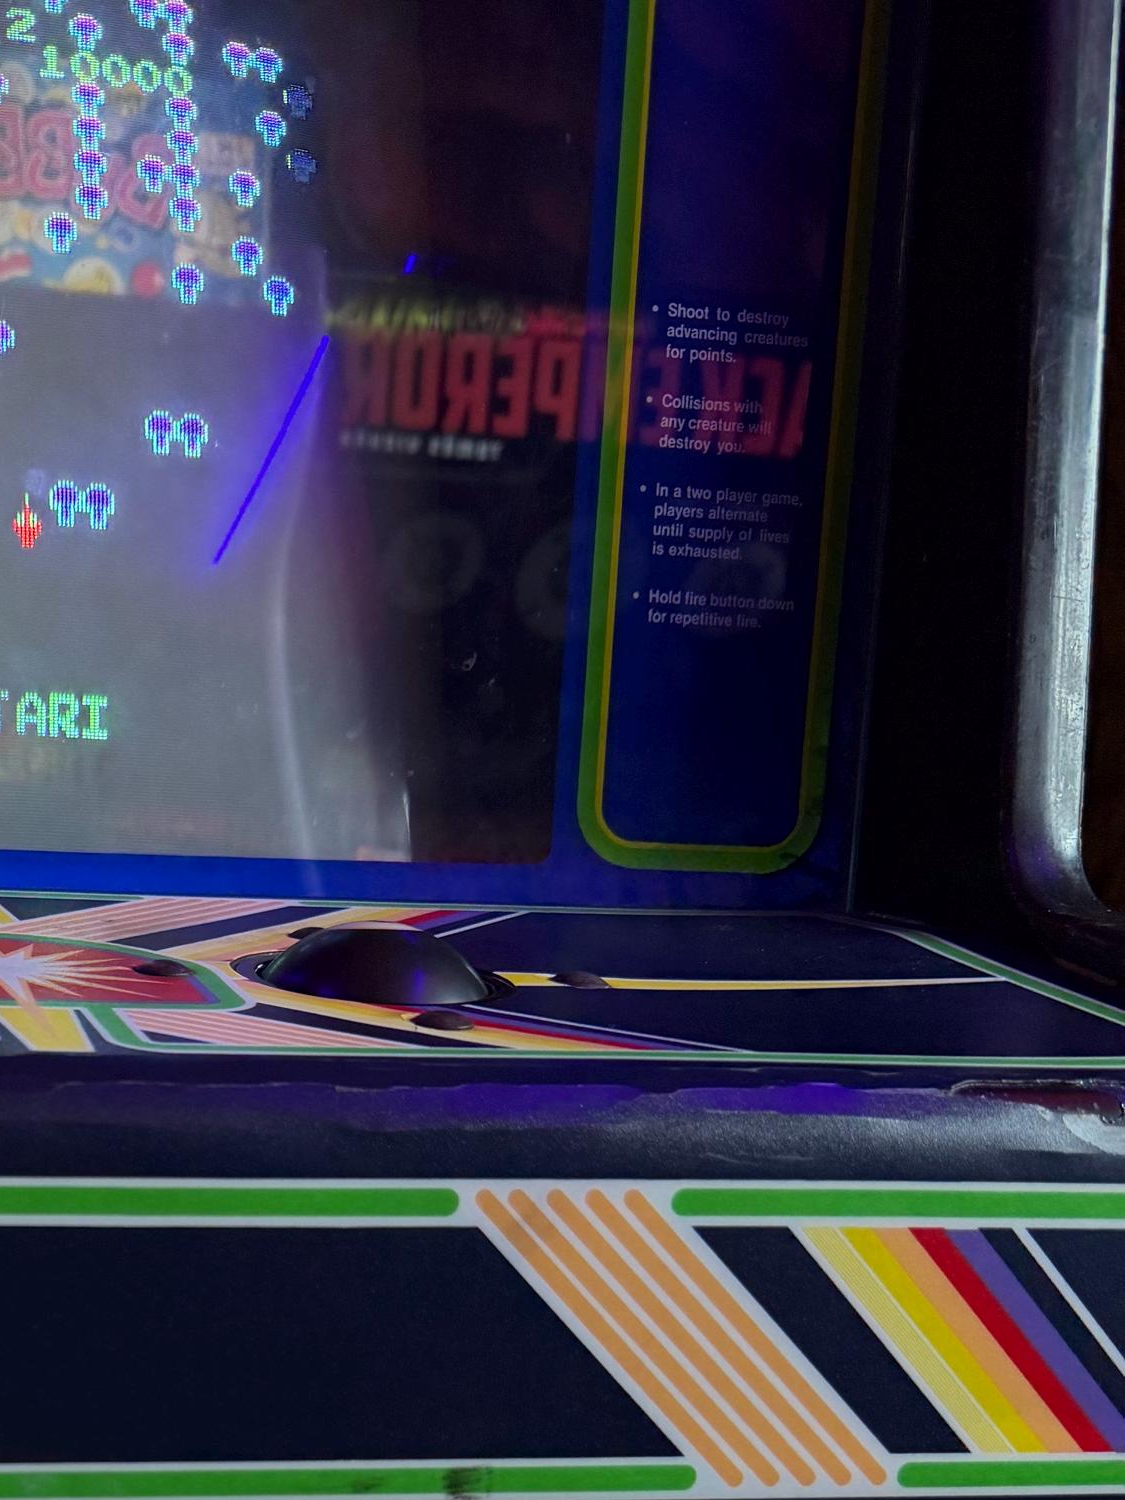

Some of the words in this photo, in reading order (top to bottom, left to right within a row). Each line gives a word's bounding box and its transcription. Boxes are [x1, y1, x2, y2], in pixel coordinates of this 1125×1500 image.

[6, 7, 36, 43] 2
[39, 46, 193, 96] 10000
[668, 302, 709, 320] Shoot
[716, 308, 730, 321] to
[737, 309, 790, 328] destroy
[666, 324, 737, 346] advancing
[744, 331, 809, 348] creatures
[666, 344, 686, 360] for
[689, 347, 737, 364] points.
[661, 393, 731, 413] Collisions
[734, 398, 763, 415] with
[660, 416, 686, 432] any
[688, 418, 745, 433] creature
[748, 421, 772, 436] will
[658, 434, 711, 455] destroy
[716, 440, 746, 456] you.
[655, 482, 669, 497] In
[673, 486, 682, 499] a
[686, 485, 712, 501] two
[716, 488, 757, 505] player
[762, 493, 803, 508] game,
[653, 502, 704, 521] players
[708, 507, 768, 523] alternate
[652, 523, 684, 538] until
[688, 525, 733, 544] supply
[738, 527, 753, 542] of
[759, 529, 790, 544] lives
[651, 541, 665, 556] is
[668, 543, 743, 561] exhausted.
[648, 588, 682, 605] Hold
[684, 590, 707, 606] fire
[709, 592, 755, 609] button
[757, 597, 795, 613] down
[647, 608, 667, 624] for
[669, 612, 733, 628] repetitive
[736, 612, 762, 629] fire.
